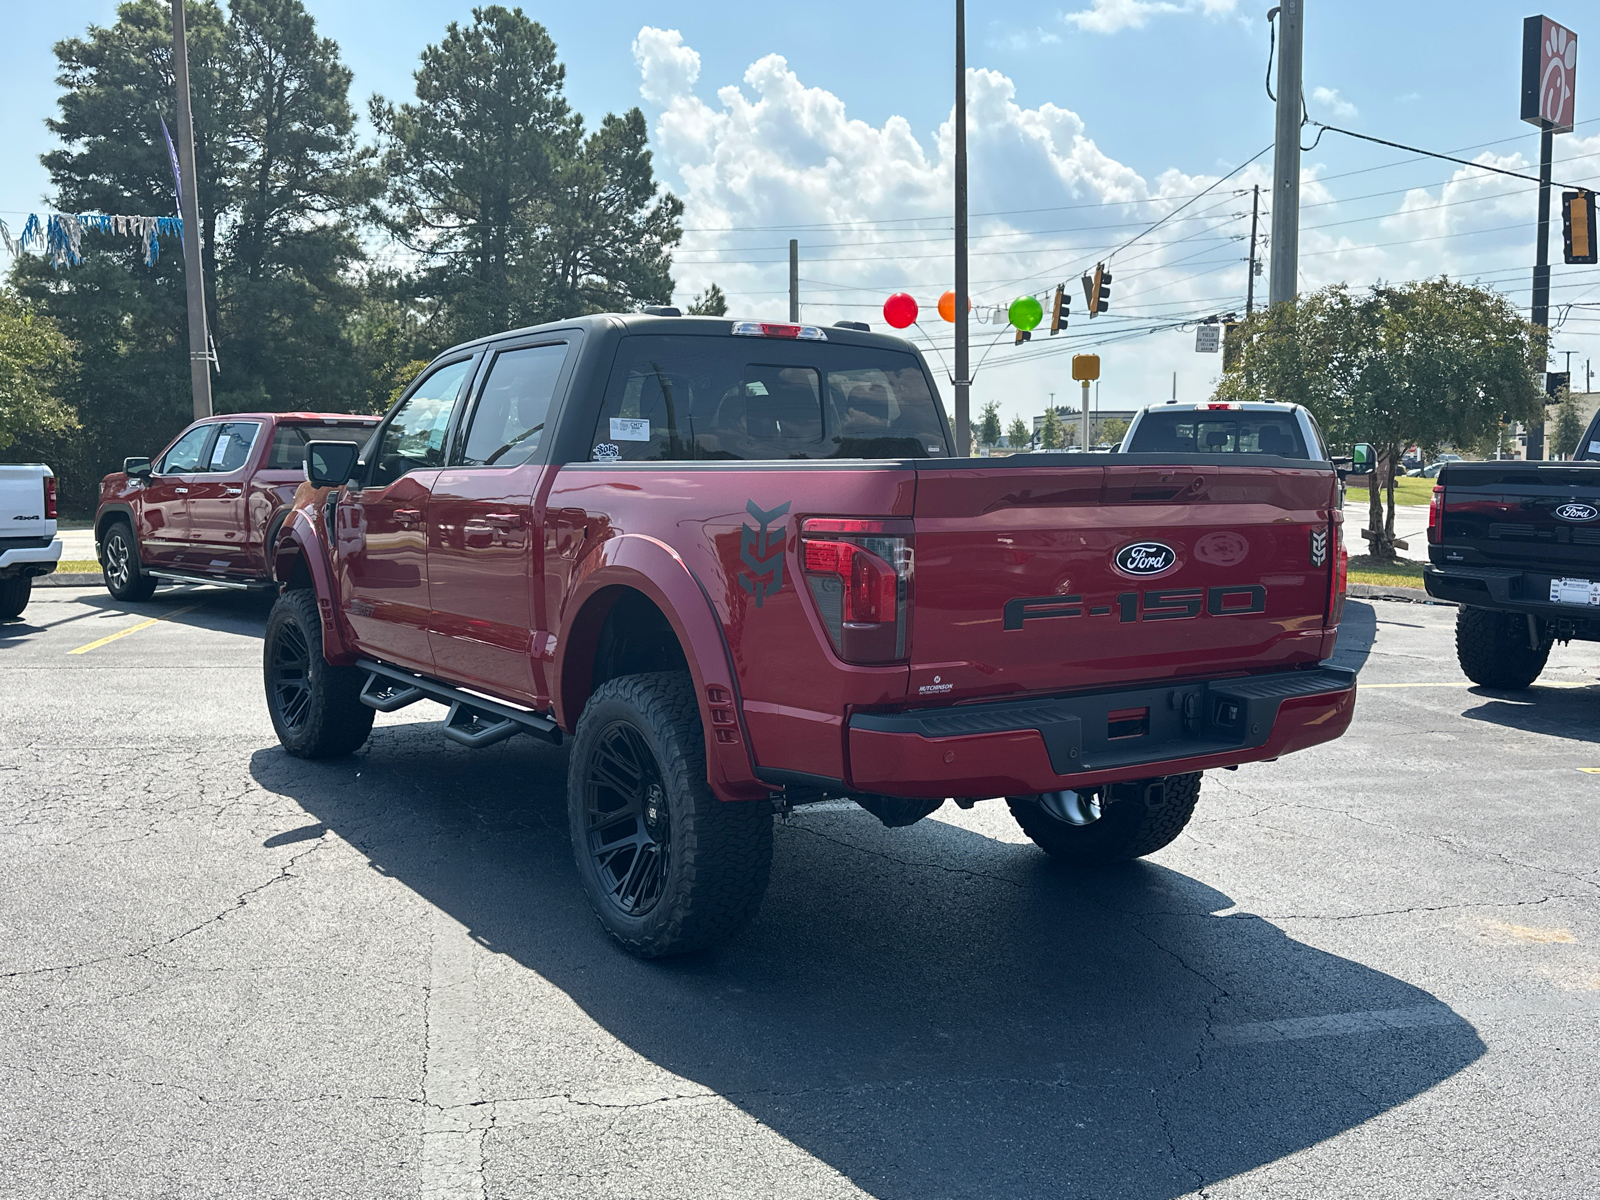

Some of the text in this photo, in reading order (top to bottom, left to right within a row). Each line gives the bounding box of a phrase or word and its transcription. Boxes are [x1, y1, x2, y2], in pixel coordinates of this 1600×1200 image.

[1562, 506, 1590, 518] Ford
[1126, 546, 1166, 569] Ford
[1003, 584, 1267, 632] F-150
[918, 684, 954, 692] HUTCHINSON
